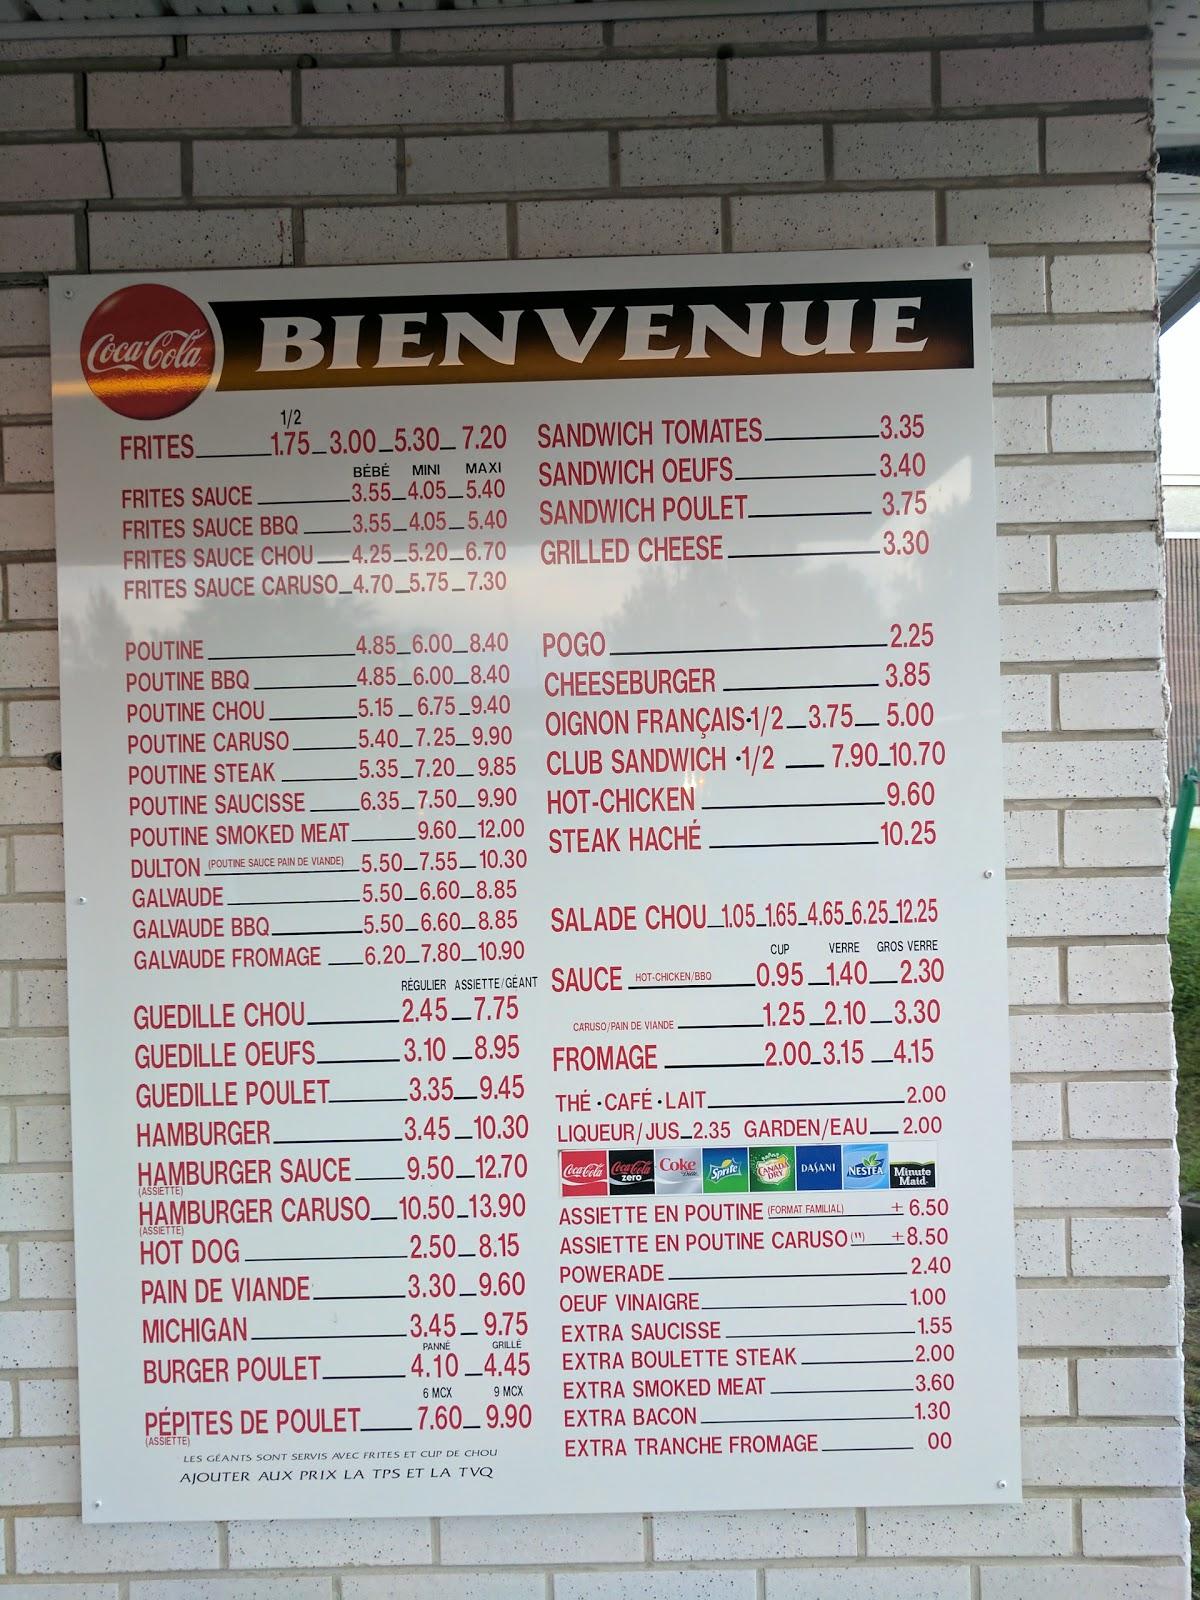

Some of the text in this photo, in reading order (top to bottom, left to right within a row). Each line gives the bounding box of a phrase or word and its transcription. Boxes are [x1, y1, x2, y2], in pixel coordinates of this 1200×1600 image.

[256, 297, 929, 372] BIENVENUE
[87, 328, 207, 374] Coca-Cola
[281, 409, 301, 429] 1/2
[538, 414, 924, 448] SANDWICH TOMATES 3.35
[121, 425, 506, 460] FRITES 1.75 3.00 5.30 7.20
[354, 462, 501, 477] BÉBÉ MINI MAXI
[540, 489, 927, 525] SANDWICH POULET 3.75
[123, 541, 506, 570] FRITES SAUCE CHOU 4.25 5.20 6.70
[539, 530, 929, 565] GRILLED CHEESE 3.30
[126, 632, 508, 661] POUTINE 4.85 6.00 8.40
[543, 623, 933, 657] POGO 2.25
[545, 662, 930, 697] CHEESEBURGER 3.85
[128, 726, 512, 754] POUTINE CARUSO 5.40 7.25 9.90
[130, 787, 517, 816] POUTINE SAUCISSE 6.35 7.50 9.90
[547, 781, 934, 814] HOT-CHICKEN 9.60
[549, 819, 936, 853] STEAK HACHÉ 10.25
[131, 858, 200, 878] DULTON
[248, 858, 275, 867] SAUCE
[278, 857, 295, 866] PAIN
[298, 857, 308, 866] DE
[311, 856, 344, 866] VIANDE)
[362, 853, 402, 873] 5.50
[420, 851, 457, 871] 7.55
[480, 849, 527, 868] 10.30
[552, 898, 938, 932] SALADE CHOU 1.05 1.65 4.65 6.25 12.25
[134, 940, 524, 970] GALVAUDE FROMAGE 6.20 7.80 10.90
[771, 940, 938, 955] CUP VERRE GROS VERRE
[401, 977, 538, 992] RÉGULIER ASSIETTE/GÉANT
[552, 958, 944, 992] SAUCE HOT-CHICKEN/BBQ 0.95 1.40 2.30
[631, 1021, 641, 1030] DE
[645, 1020, 674, 1030] VIANDE
[763, 1002, 805, 1026] 1.25
[825, 1001, 866, 1025] 2.10
[895, 999, 940, 1024] 3.30
[135, 1035, 519, 1069] GUEDILLE OEUFS 3.10 8.95
[553, 1038, 933, 1071] FROMAGE 2.00 3.15 4.15
[137, 1115, 528, 1147] HAMBURGER 3.45 10.30
[563, 1164, 602, 1179] Coca-Cola
[611, 1161, 654, 1182] Coca-Cola zero
[659, 1158, 696, 1172] Coke
[711, 1164, 739, 1180] Sprite
[768, 1170, 783, 1179] DRY
[849, 1166, 882, 1176] NESTEA
[894, 1168, 931, 1177] Minute
[138, 1186, 184, 1197] (ASSIETTE)
[139, 1226, 184, 1236] (ASSIETTE)
[560, 1257, 951, 1283] POWERADE 2.40
[143, 1312, 528, 1343] MICHIGAN 3.45 9.75
[423, 1340, 522, 1350] PANNÉ GRILLÉ
[423, 1385, 523, 1398] 6 MCX 9 MCX
[565, 1401, 950, 1427] EXTRA BACON 1.30
[145, 1436, 190, 1447] (ASSIETTE)
[332, 1452, 359, 1460] AVEC
[364, 1451, 400, 1459] FRITES
[464, 1449, 497, 1457] CHOU
[565, 1439, 627, 1457] EXTRA
[634, 1437, 722, 1455] TRANCHE
[730, 1434, 818, 1453] FROMAGE
[180, 1467, 493, 1485] AJOUTER AUX PRIX LA TPS ET LA TVQ
